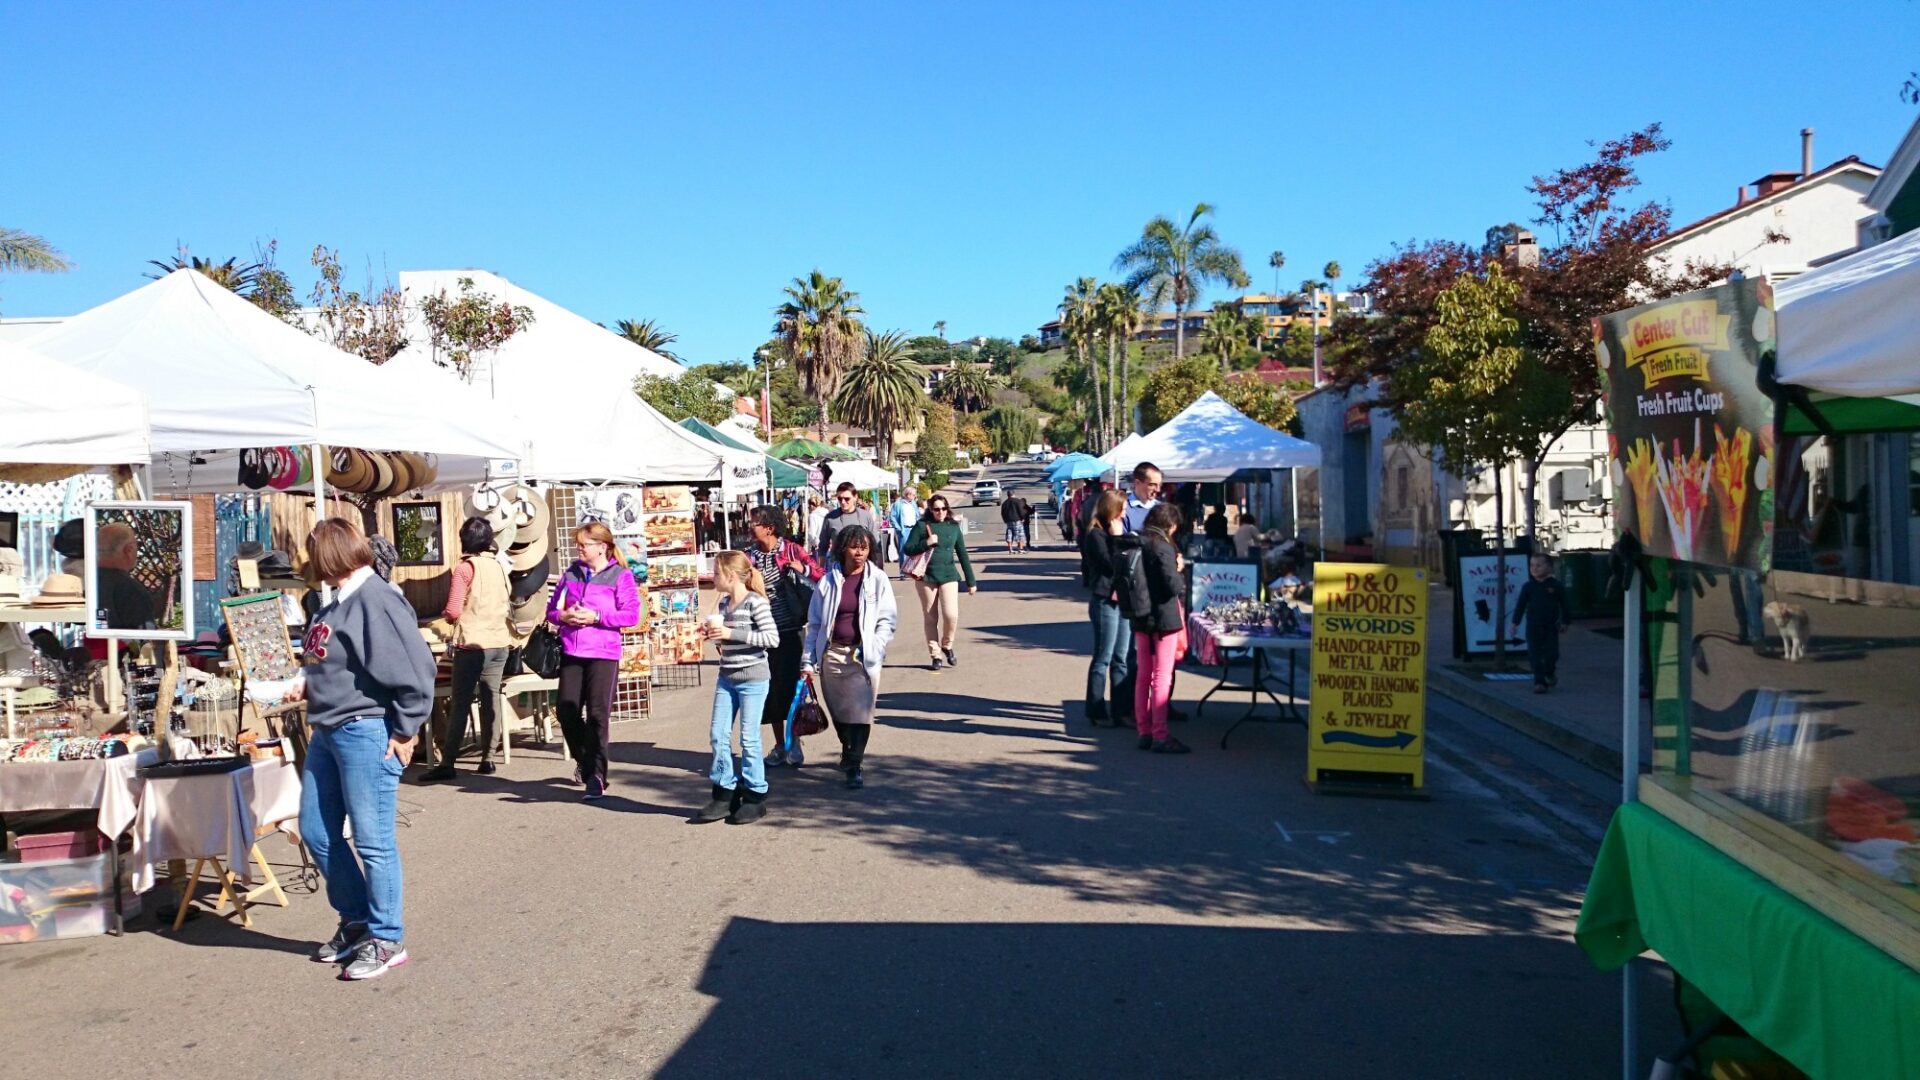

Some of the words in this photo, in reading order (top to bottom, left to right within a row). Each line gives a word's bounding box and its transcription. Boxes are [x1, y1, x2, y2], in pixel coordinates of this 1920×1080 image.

[1633, 320, 1677, 348] Center
[1681, 307, 1709, 337] Cut
[1650, 358, 1672, 376] Fresh
[1675, 354, 1698, 371] Fruit
[1637, 395, 1664, 416] Fresh
[1666, 391, 1693, 415] Fruit
[1694, 388, 1723, 415] Cups
[1200, 572, 1250, 585] MAGIC
[1468, 564, 1521, 576] MAIC
[1476, 584, 1515, 596] SHP
[1327, 592, 1416, 615] IMPORTS
[1325, 617, 1415, 635] SWORDS
[1318, 637, 1421, 657] HANDCRAFTED
[1328, 655, 1374, 671] METAL
[1379, 656, 1409, 672] ART
[1317, 674, 1366, 691] WOODEN
[1371, 676, 1420, 693] HANGING
[1325, 711, 1338, 726] &
[1344, 711, 1411, 729] JEWELRY
